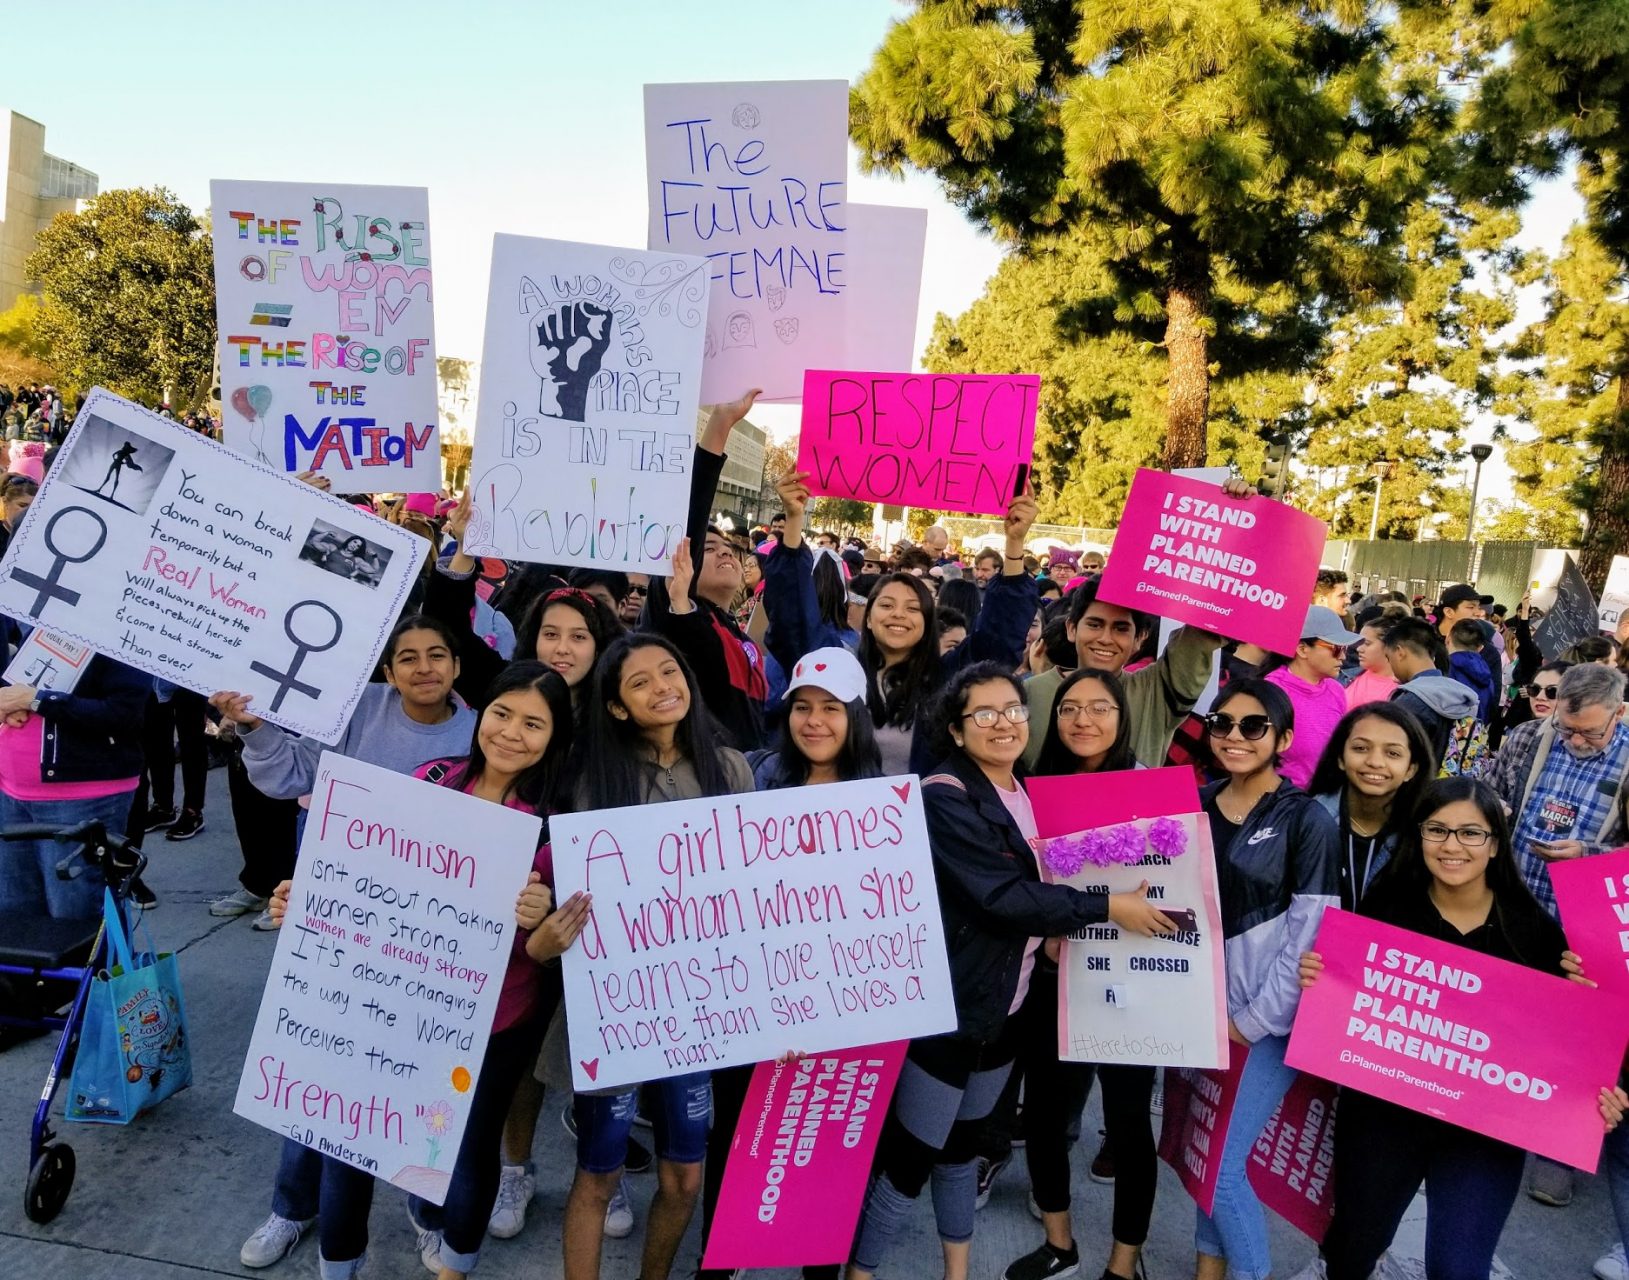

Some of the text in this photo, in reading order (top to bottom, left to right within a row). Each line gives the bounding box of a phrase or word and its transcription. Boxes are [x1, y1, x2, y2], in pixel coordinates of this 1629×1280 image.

[666, 118, 771, 175] The
[229, 197, 429, 266] THE RISE
[239, 250, 294, 286] OF
[705, 245, 847, 299] FEMALE
[519, 275, 548, 314] A
[227, 335, 307, 367] THE
[384, 339, 430, 376] OF
[309, 381, 367, 406] THE
[828, 377, 1038, 457] RESPECT
[284, 414, 435, 472] NATION
[569, 426, 608, 466] IN
[813, 445, 1017, 508] WOMEN
[160, 501, 273, 559] down a woman
[178, 468, 293, 542] You can break
[473, 463, 684, 563] Revolution
[1159, 513, 1223, 544] WITH
[1162, 492, 1256, 529] I STAND
[150, 518, 257, 581] temporarily but a
[1149, 533, 1257, 577] PLANNED
[142, 545, 267, 620] Real Woman
[1146, 585, 1182, 601] Planned
[156, 585, 195, 608] always
[196, 604, 217, 618] pick
[218, 615, 230, 625] up
[232, 616, 250, 633] the
[165, 608, 203, 630] rebuild
[205, 623, 242, 648] herself
[119, 629, 193, 673] than ever!
[159, 624, 182, 644] back
[186, 639, 224, 660] stronger
[1540, 809, 1575, 828] MARCH
[658, 808, 726, 903] girl
[735, 804, 904, 868] becomes
[310, 858, 349, 883] isn't
[355, 876, 419, 909] about
[1147, 886, 1165, 899] MY
[1604, 877, 1618, 898] I
[581, 867, 920, 960] a woman when she
[305, 915, 346, 940] women
[353, 932, 372, 948] are
[381, 941, 429, 974] already
[1087, 956, 1189, 973] SHE CROSSED
[1365, 942, 1482, 994] I STAND
[283, 968, 309, 995] the
[319, 985, 350, 1015] way
[362, 997, 398, 1027] the
[291, 924, 477, 1020] It's about changing
[588, 923, 927, 1020] learns to love herself
[1363, 967, 1441, 1010] WITH
[598, 975, 926, 1055] more than she loves a
[1352, 992, 1491, 1053] PLANNED
[364, 1046, 420, 1079] that
[764, 1068, 783, 1106] Planned
[1352, 1055, 1396, 1078] Planned
[793, 1058, 840, 1167] PLANNED
[827, 1059, 862, 1121] WITH
[843, 1059, 884, 1149] I STAND
[318, 1137, 378, 1172] Anderson
[1252, 1154, 1267, 1168] I
[1269, 1121, 1297, 1177] WITH
[1287, 1098, 1326, 1192] PLANNED
